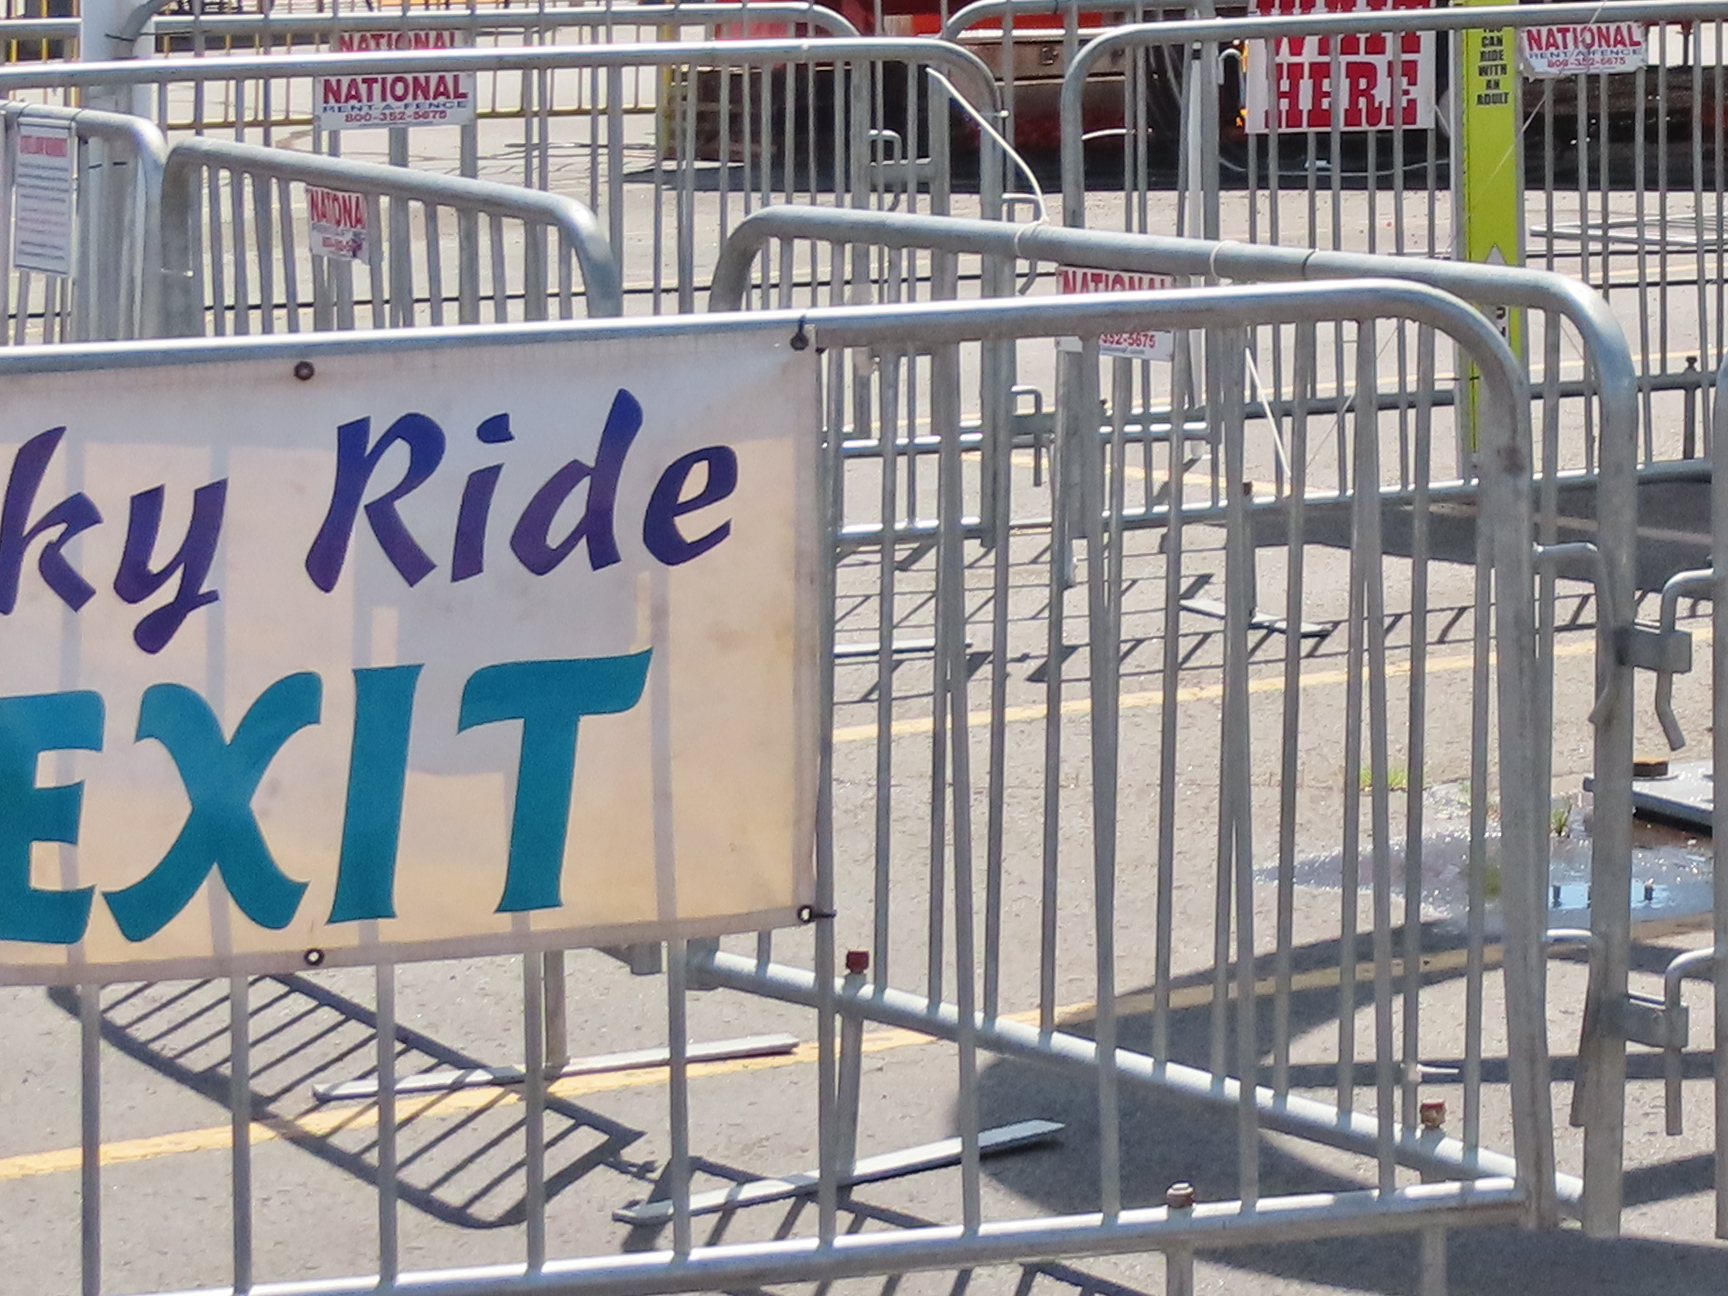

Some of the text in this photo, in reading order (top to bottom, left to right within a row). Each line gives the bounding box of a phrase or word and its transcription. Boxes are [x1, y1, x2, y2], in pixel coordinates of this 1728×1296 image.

[1482, 35, 1504, 47] CAN
[1527, 24, 1641, 51] NATIONAL
[1480, 50, 1504, 61] RIDE
[1478, 64, 1508, 76] WITH
[323, 74, 468, 104] NATIONAL
[1486, 79, 1500, 89] AN
[1265, 60, 1418, 129] HERE
[1477, 92, 1509, 105] ADULT
[304, 388, 739, 594] Ride
[0, 648, 654, 945] EXIT
